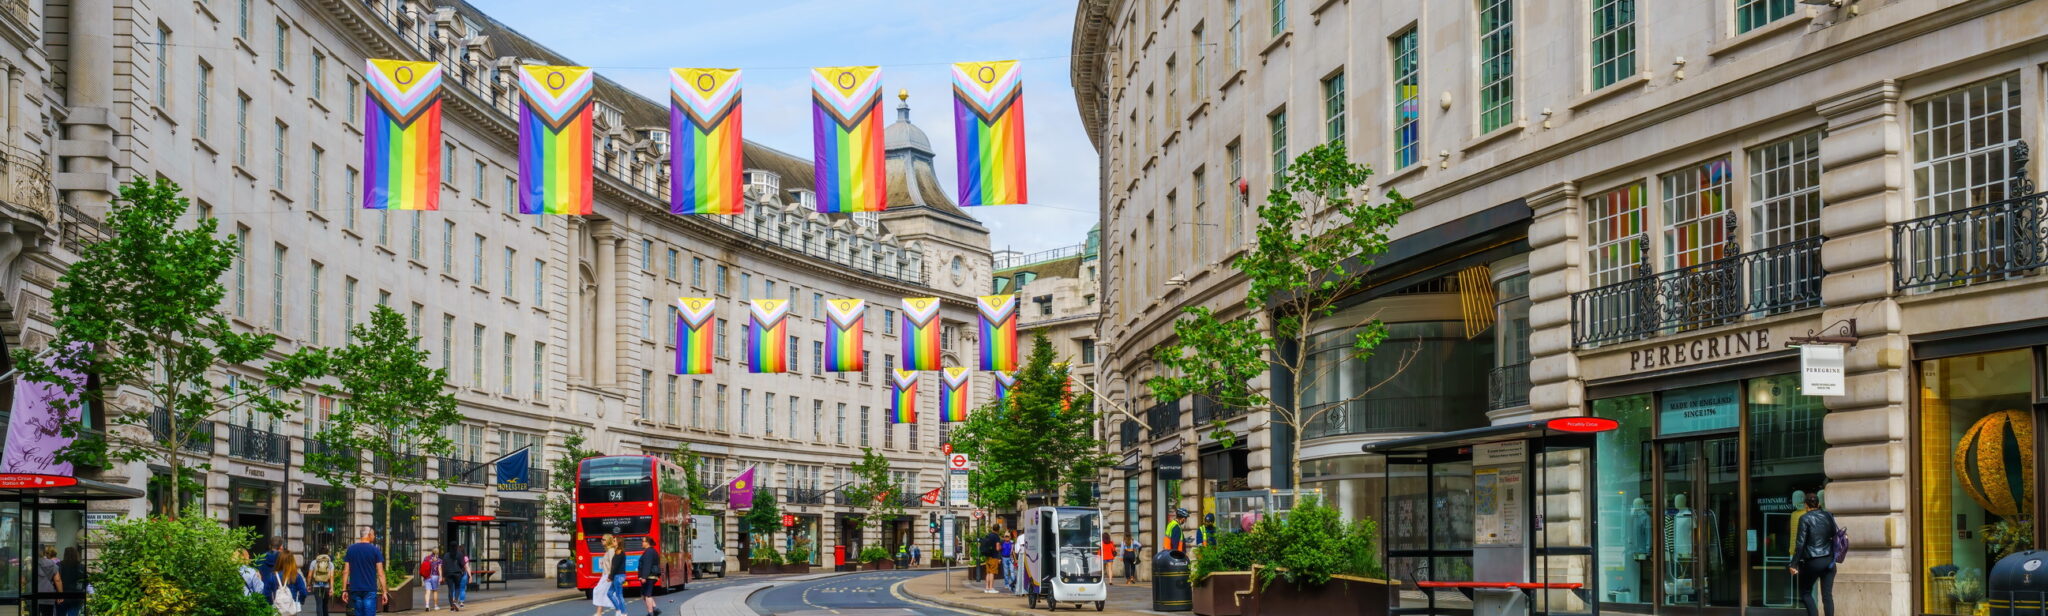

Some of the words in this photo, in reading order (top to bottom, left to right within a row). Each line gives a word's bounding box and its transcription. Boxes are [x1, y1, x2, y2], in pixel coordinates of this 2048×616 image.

[1630, 329, 1770, 370] PEREGRINE
[1670, 401, 1687, 410] MADE
[1689, 400, 1698, 408] IN
[1699, 397, 1732, 407] ENGLAND
[1683, 409, 1703, 418] SINCE
[22, 446, 58, 470] Caff
[497, 482, 528, 491] HOLLISTER
[610, 490, 622, 500] 94
